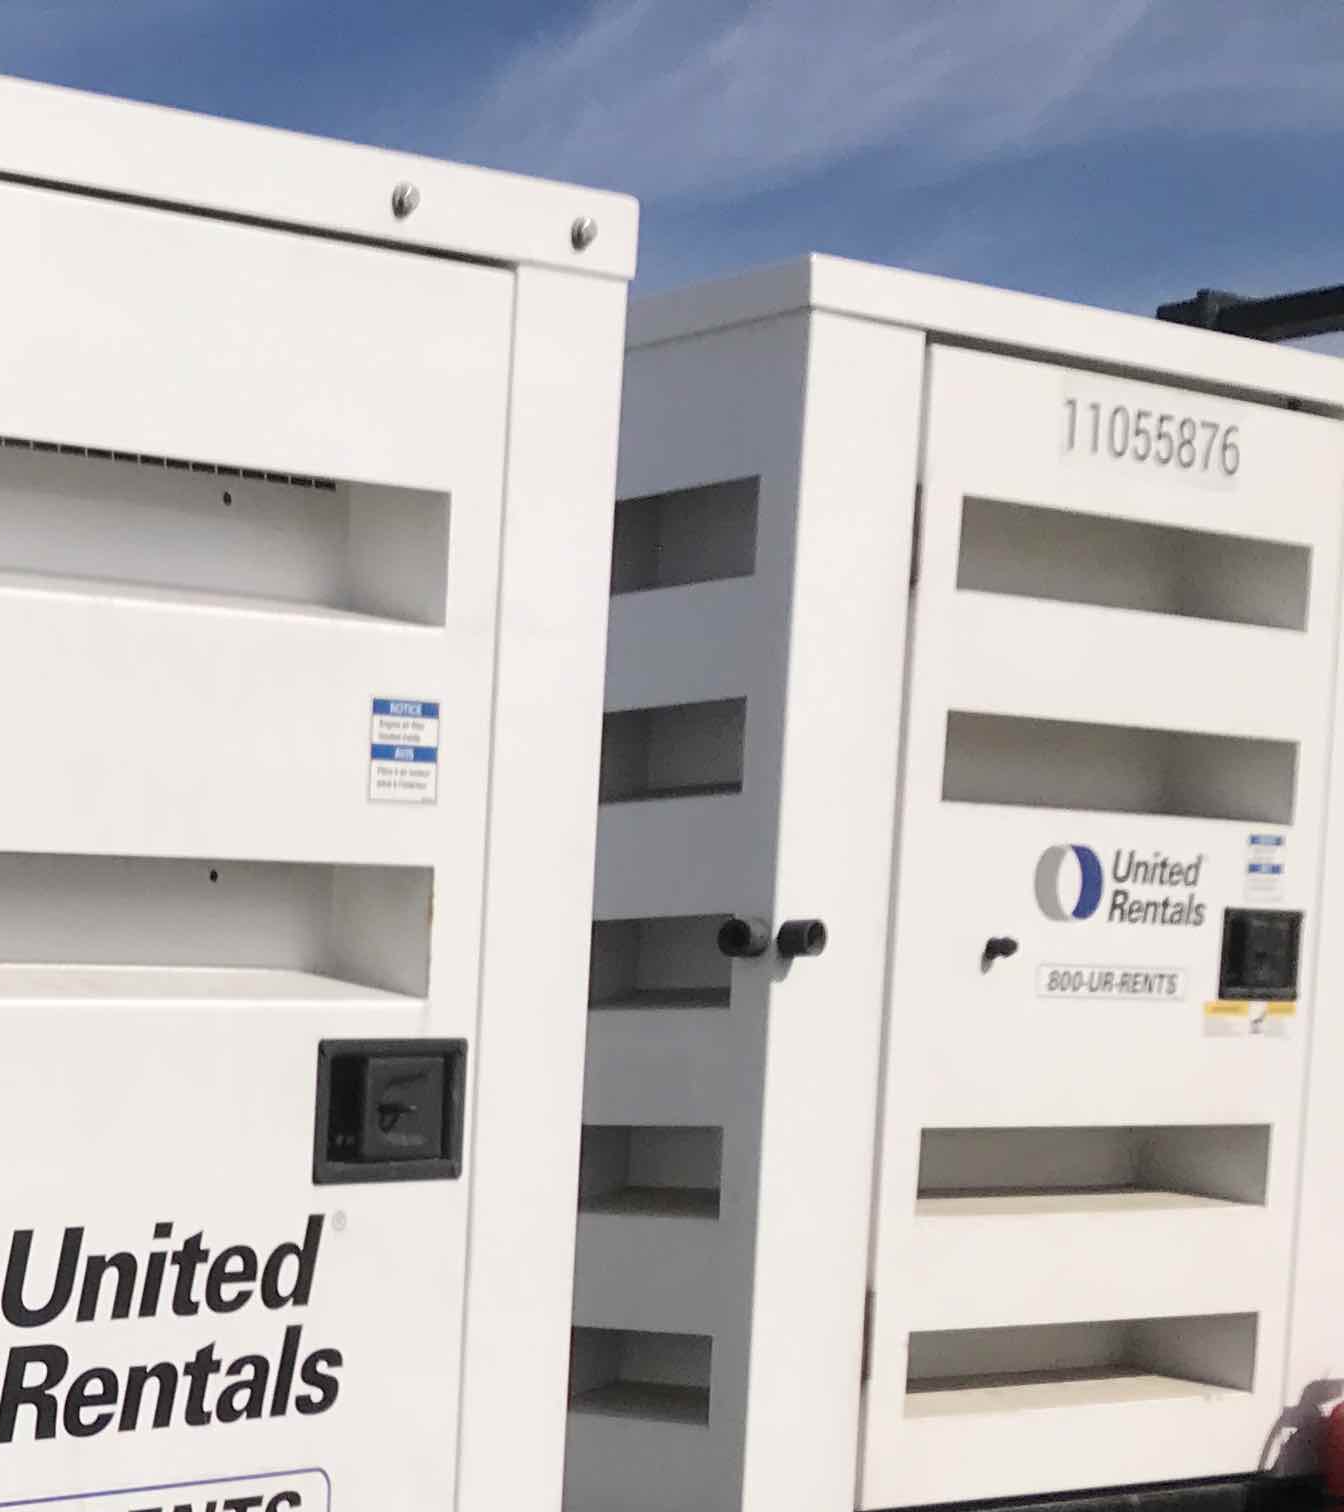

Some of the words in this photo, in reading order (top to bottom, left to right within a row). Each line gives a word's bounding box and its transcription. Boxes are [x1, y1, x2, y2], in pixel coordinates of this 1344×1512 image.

[1063, 397, 1241, 476] 11055876
[1111, 847, 1205, 888] United
[1107, 887, 1207, 927] Rentals
[1046, 968, 1179, 996] 800-UR-RENTS
[0, 1213, 326, 1329] United
